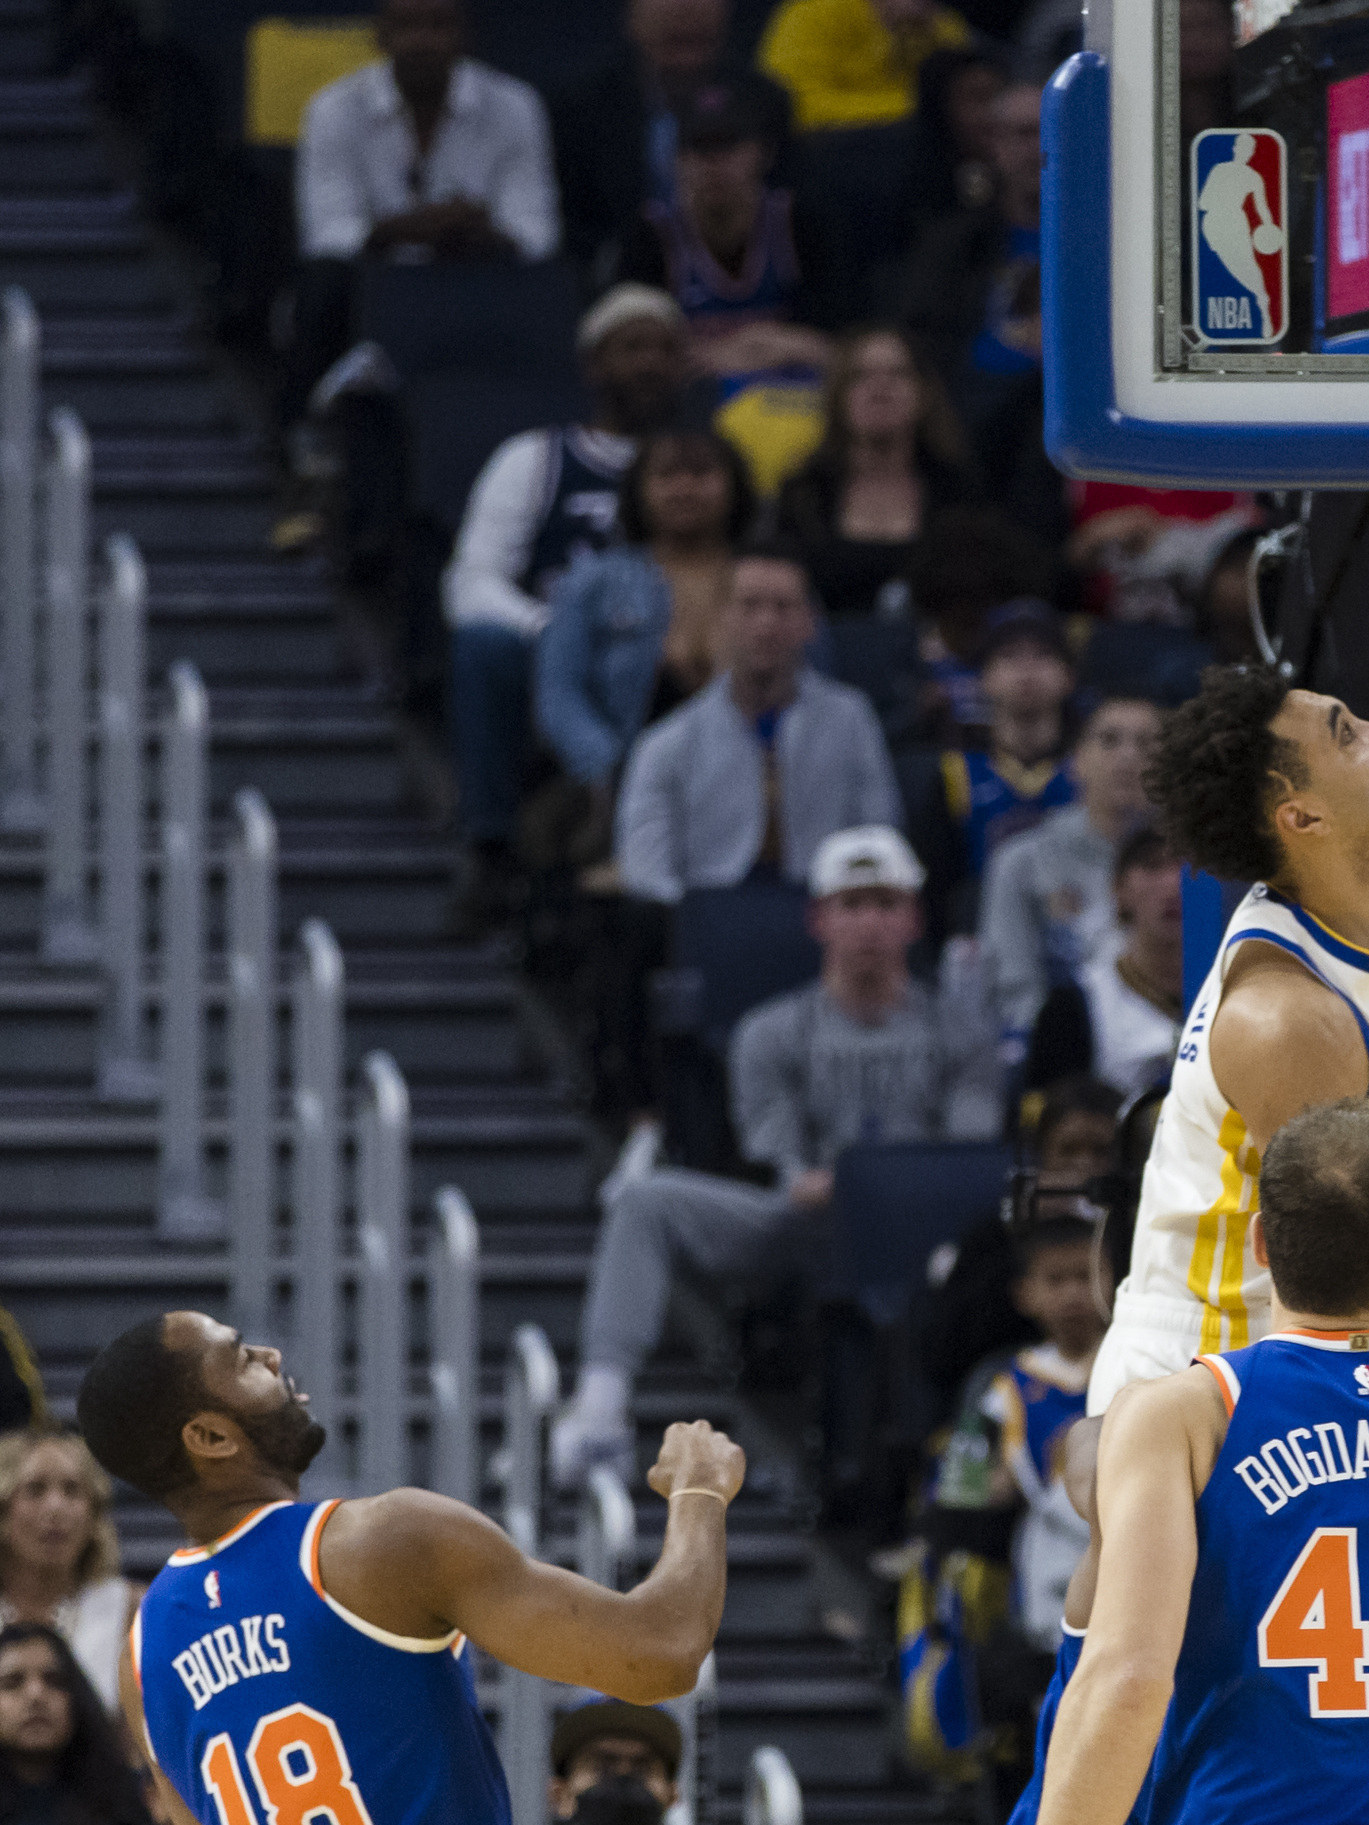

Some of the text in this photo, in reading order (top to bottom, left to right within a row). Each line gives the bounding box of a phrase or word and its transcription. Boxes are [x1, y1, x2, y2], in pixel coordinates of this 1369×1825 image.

[1207, 296, 1253, 329] NBA
[171, 1613, 291, 1711] BURKS
[200, 1702, 374, 1825] 18
